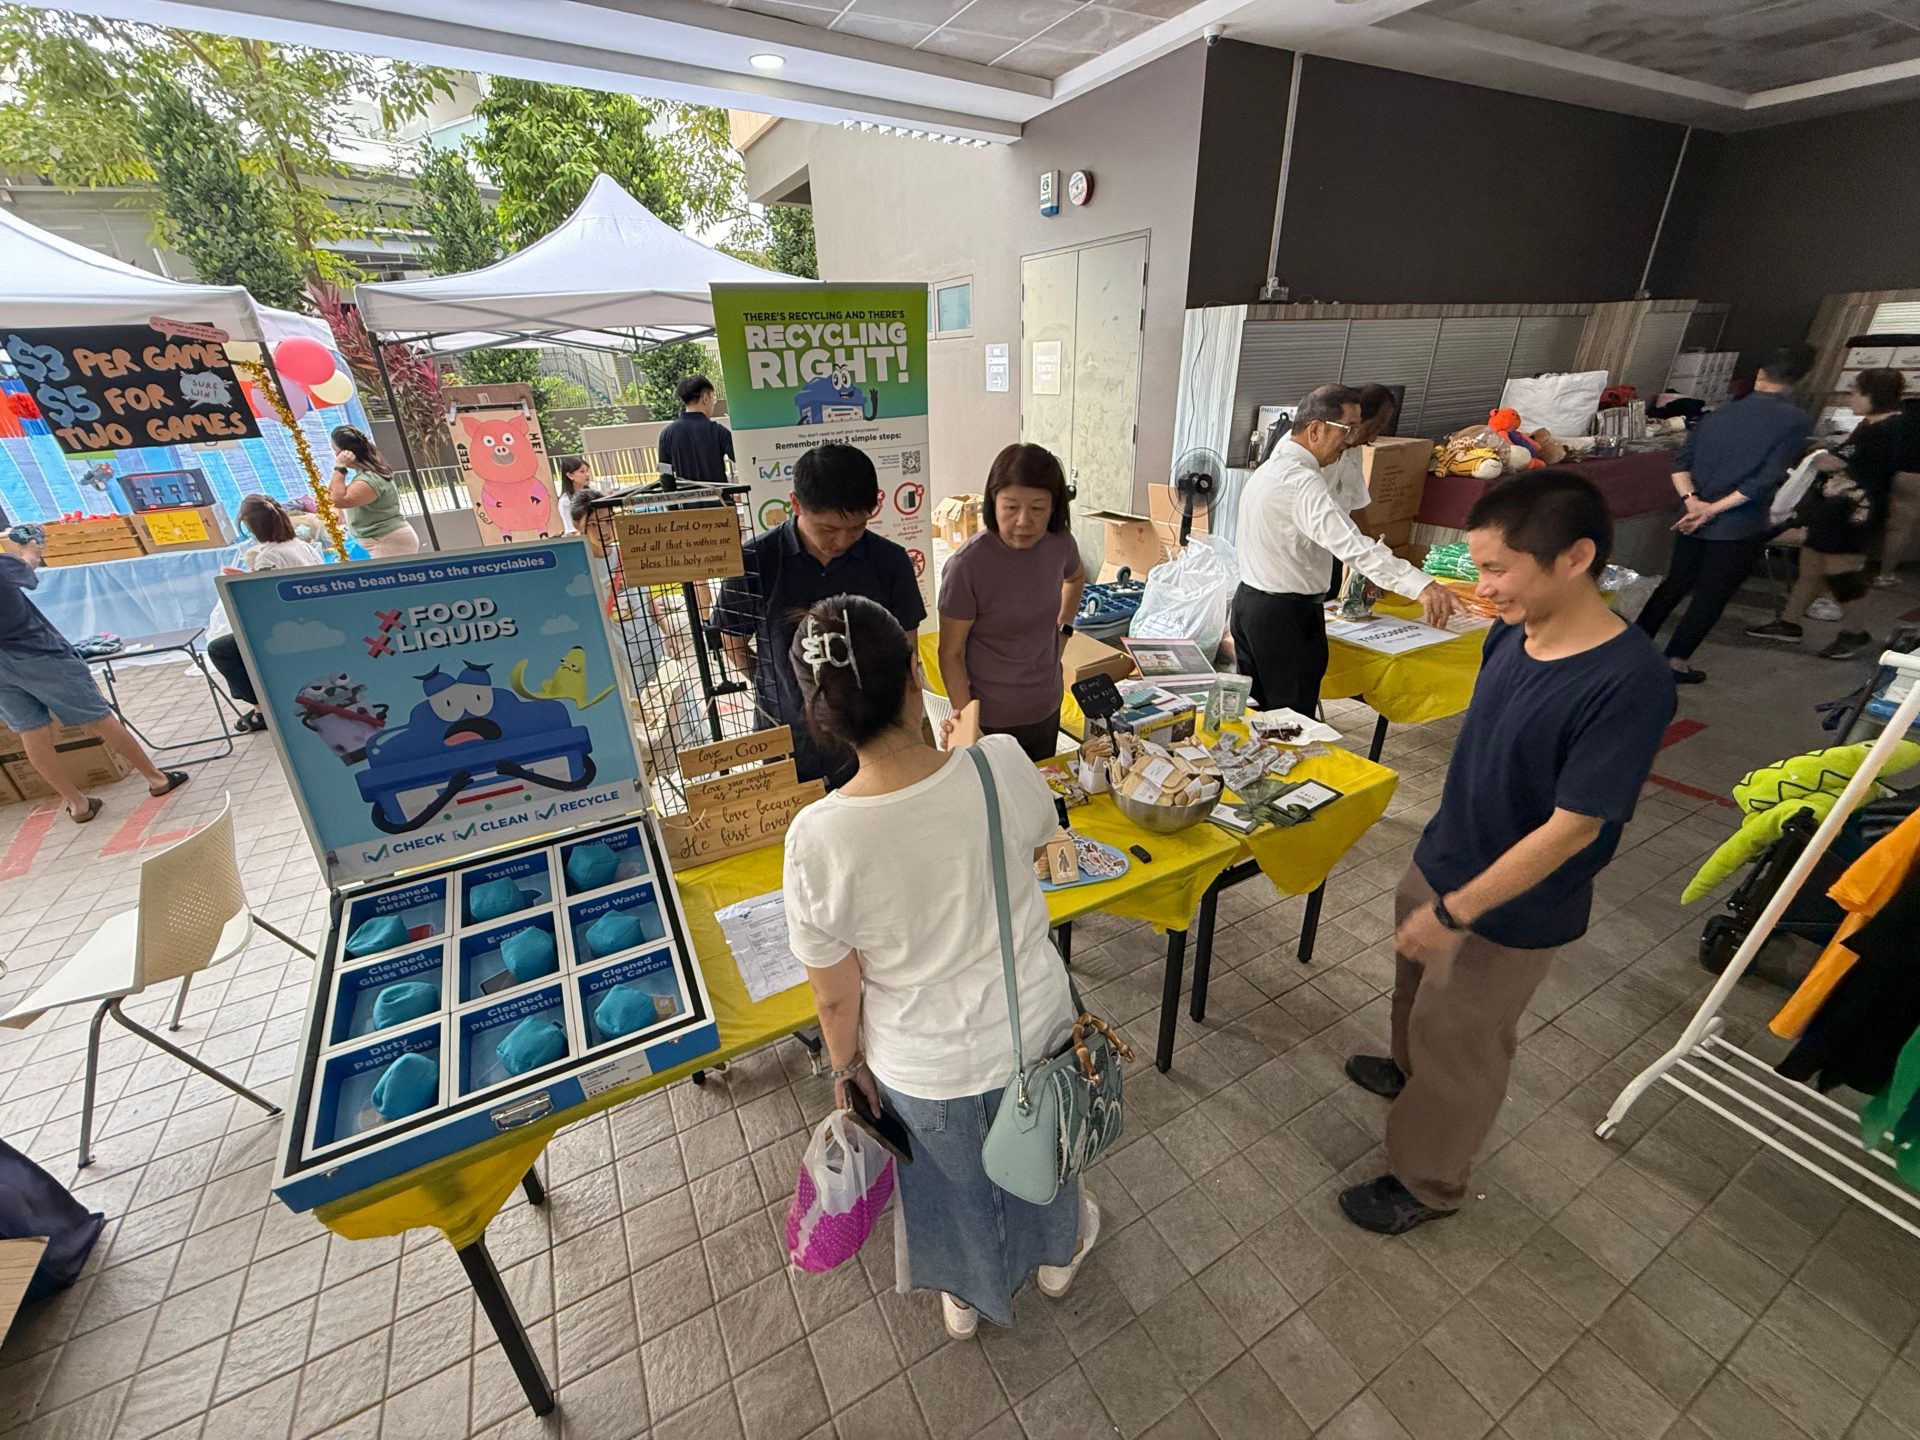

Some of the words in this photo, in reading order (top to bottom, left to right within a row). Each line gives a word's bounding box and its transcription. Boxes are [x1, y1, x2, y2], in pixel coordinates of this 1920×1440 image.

[743, 311, 786, 321] THERE'S
[788, 311, 842, 321] RECYCLING
[845, 310, 866, 320] AND
[869, 310, 905, 319] THERE'S
[744, 322, 907, 350] RECYCLING
[7, 334, 70, 382] $3
[73, 348, 141, 378] PER
[143, 343, 229, 371] GAME
[747, 346, 909, 390] RIGHT!
[192, 380, 218, 389] SURE
[36, 383, 101, 429] $5
[104, 383, 174, 415] FOR
[55, 422, 133, 450] TWO
[146, 412, 247, 442] GAMES
[775, 439, 820, 450] Remember
[821, 437, 843, 446] these
[844, 435, 850, 444] 3
[851, 433, 877, 443] simple
[456, 443, 473, 472] FEED
[628, 524, 651, 536] Bless
[655, 522, 667, 533] the
[670, 520, 690, 532] Lord
[692, 521, 701, 530] O
[701, 523, 712, 532] my
[630, 542, 647, 553] and
[650, 541, 661, 552] all
[665, 539, 683, 550] that
[685, 539, 692, 548] is
[640, 558, 661, 570] bless
[683, 554, 701, 568] holy
[292, 583, 328, 595] Toss
[330, 579, 356, 591] the
[359, 574, 396, 588] bean
[398, 570, 427, 583] bag
[429, 568, 444, 579] to
[446, 565, 469, 577] the
[472, 556, 545, 573] recyclables
[407, 597, 497, 628] FOOD
[395, 616, 518, 653] LIQUIDS
[735, 779, 773, 798] yourself
[746, 770, 777, 785] neighbor
[756, 796, 804, 815] because
[392, 832, 446, 854] CHECK
[480, 812, 529, 833] CLEAN
[559, 790, 620, 813] RECYCLE
[680, 835, 710, 859] He
[720, 824, 753, 847] first
[760, 810, 790, 833] loved
[485, 863, 531, 880] Textiles
[375, 898, 411, 913] Metal
[414, 892, 439, 902] Can
[377, 885, 430, 904] Cleaned
[579, 901, 610, 916] Food
[612, 889, 647, 906] Waste
[359, 971, 397, 986] Glass
[400, 957, 442, 974] Bottle
[368, 952, 426, 975] Cleaned
[589, 973, 624, 991] Drink
[626, 959, 668, 978] Carton
[601, 956, 652, 979] Cleaned
[470, 1010, 517, 1031] Plastic
[520, 996, 561, 1015] Bottle
[487, 993, 543, 1017] Cleaned
[353, 1050, 399, 1070] Paper
[402, 1040, 433, 1052] Cup
[369, 1039, 408, 1056] Dirty
